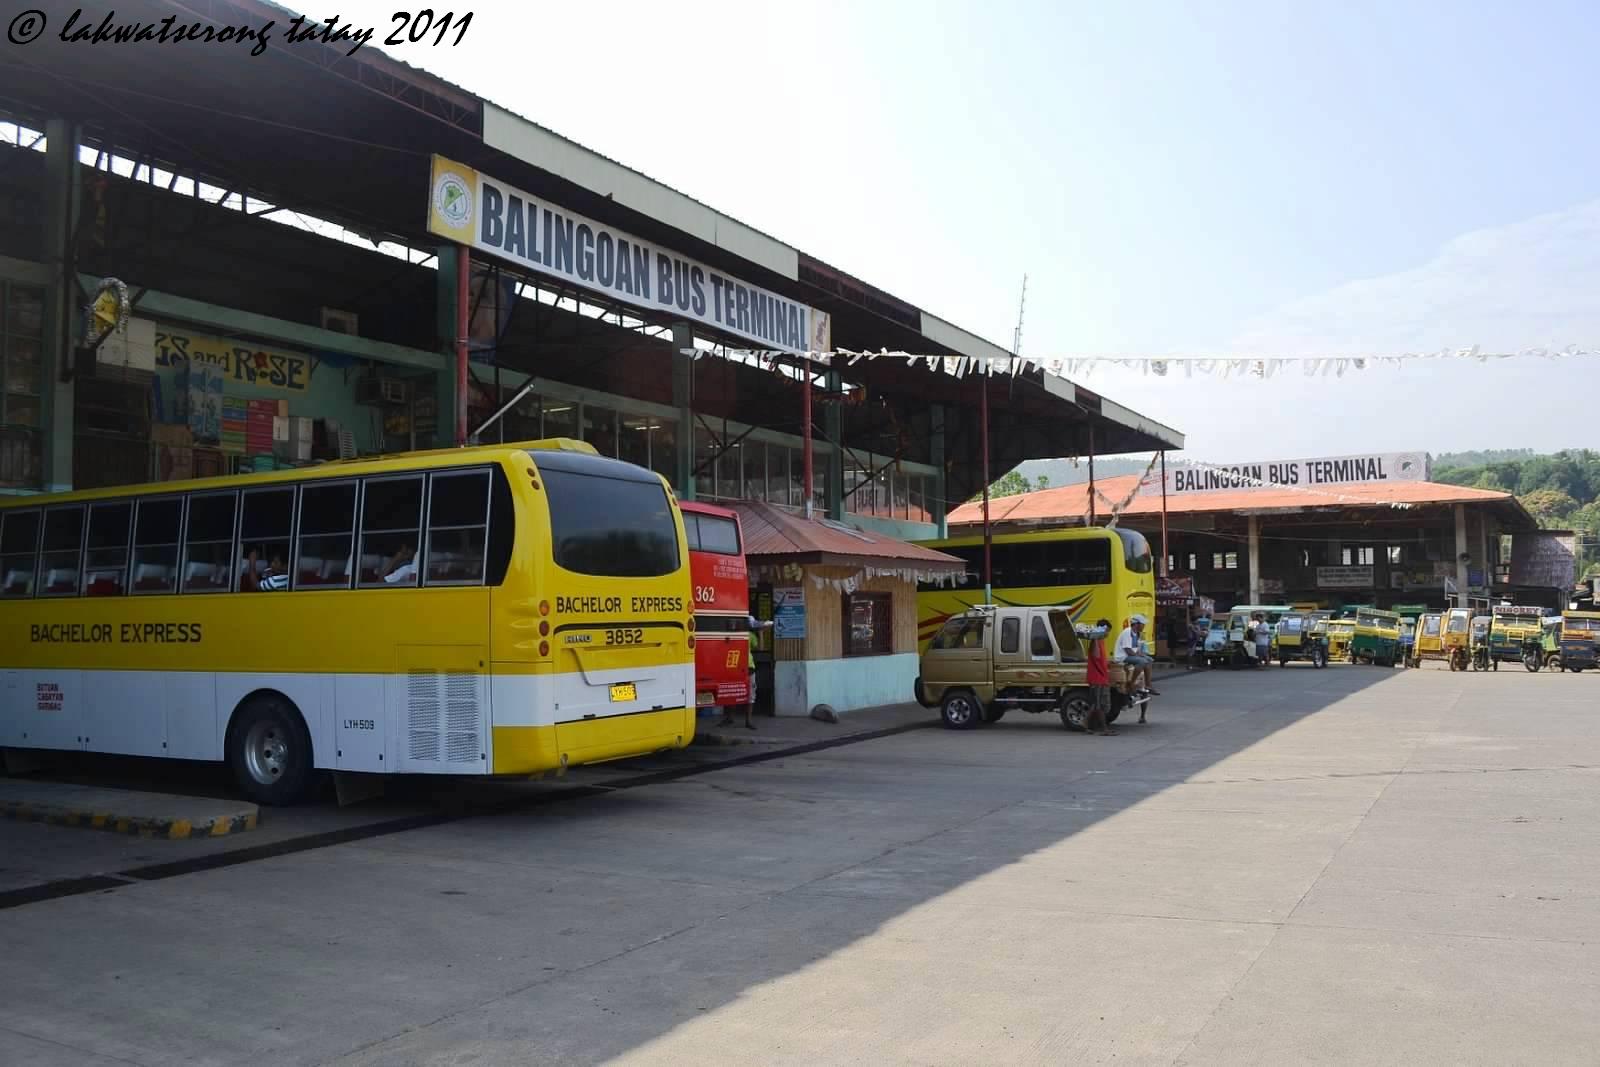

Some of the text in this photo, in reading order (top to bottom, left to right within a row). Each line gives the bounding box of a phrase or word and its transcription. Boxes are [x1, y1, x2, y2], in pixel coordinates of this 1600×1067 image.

[481, 182, 651, 300] BALINGOAN
[656, 252, 707, 317] BUS
[710, 275, 809, 352] TERMINAL
[1175, 465, 1262, 491] BALINGOAN
[1269, 463, 1299, 485] BUS
[1306, 457, 1387, 484] TERMINAL
[695, 585, 715, 602] 362
[556, 596, 683, 613] BACHELOR EXPRESS
[30, 623, 202, 643] BACHELOR EXPRESS
[605, 629, 643, 645] 3852
